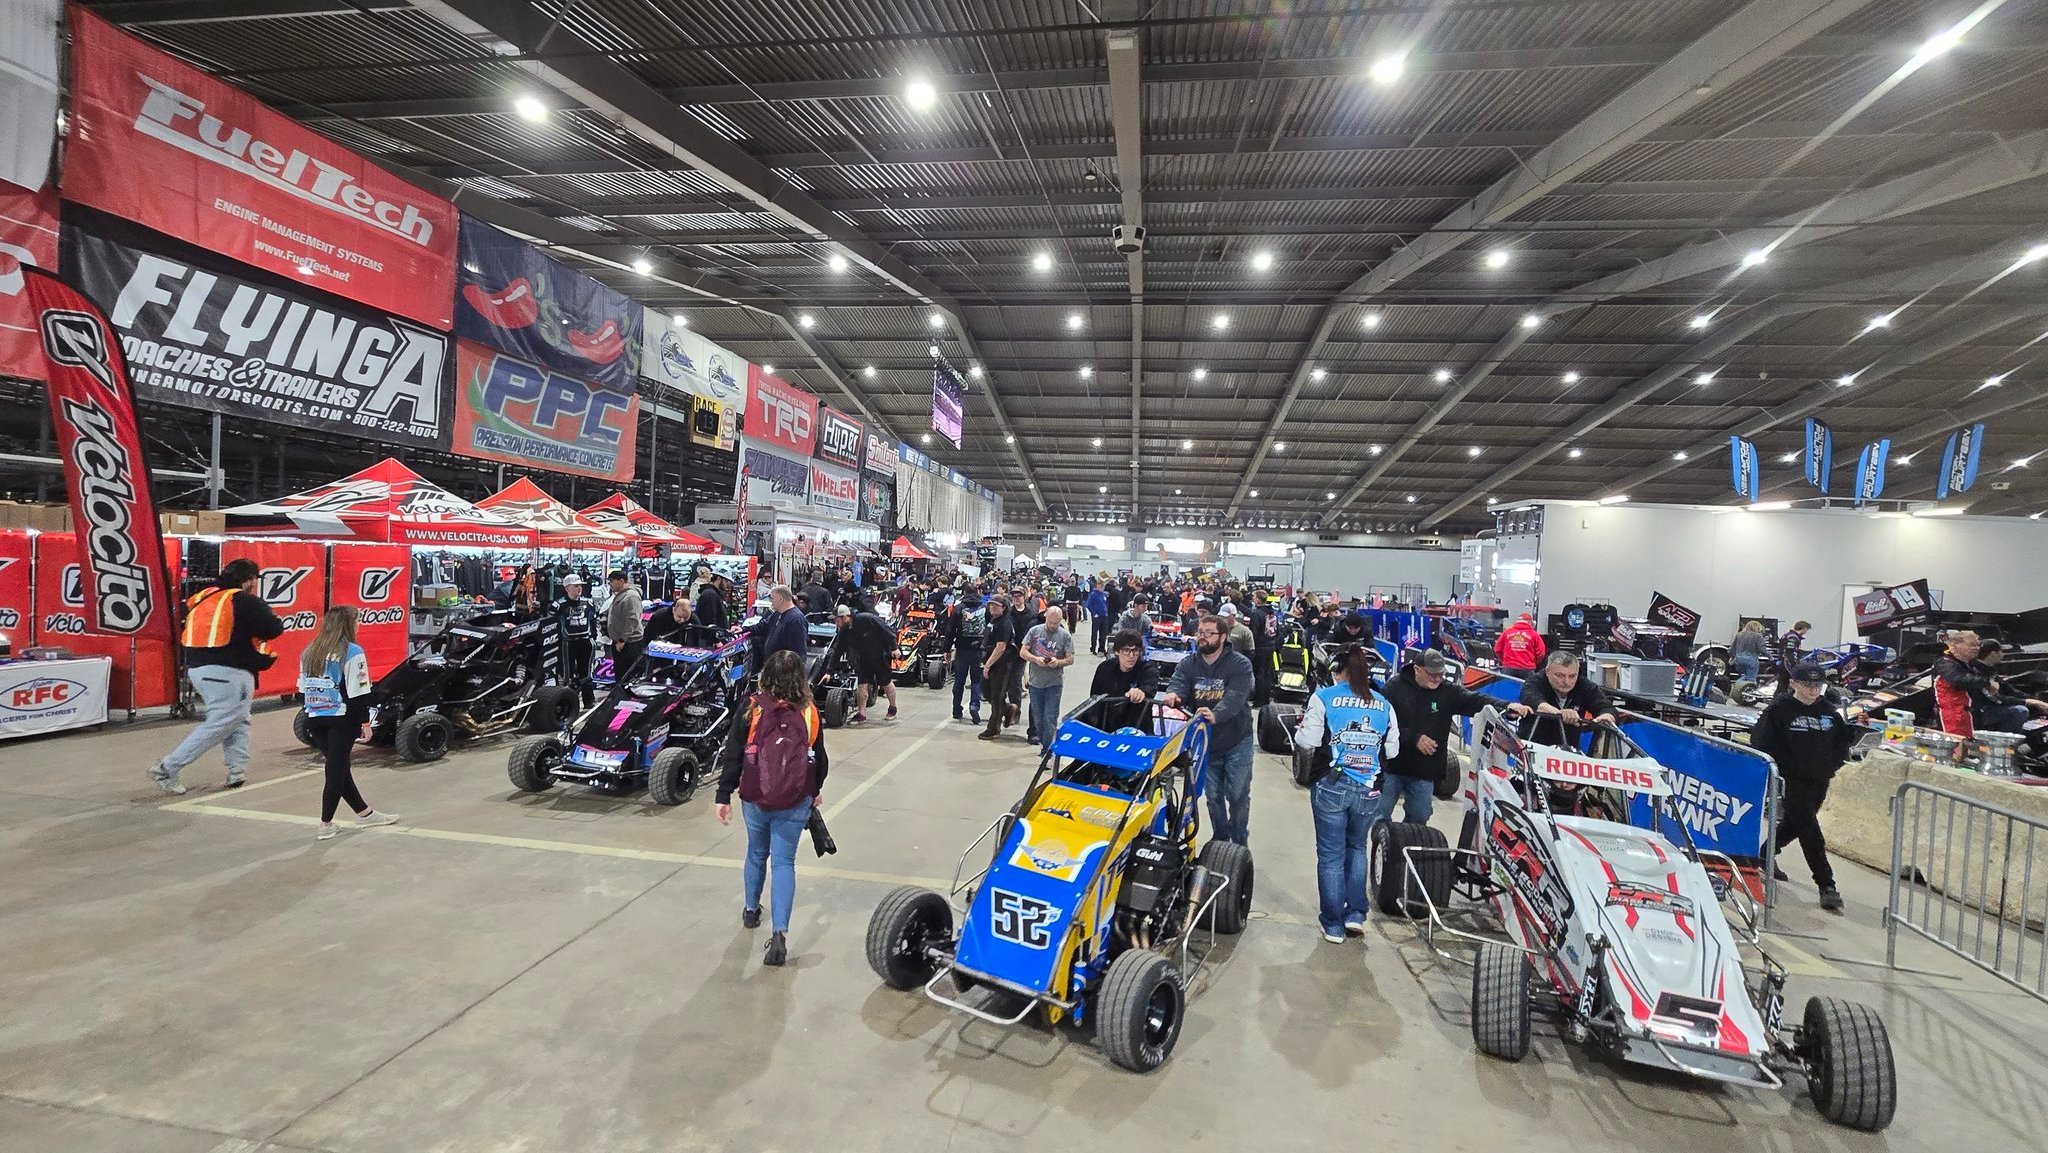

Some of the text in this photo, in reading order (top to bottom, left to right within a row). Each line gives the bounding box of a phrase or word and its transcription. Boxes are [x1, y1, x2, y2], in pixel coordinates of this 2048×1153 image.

[136, 72, 433, 246] FuelTech
[214, 198, 384, 272] ENGINE MANAGEMENT SYSTEMS
[254, 240, 350, 282] www.FuelTech.net
[119, 334, 232, 381] OACHES
[260, 369, 360, 408] TRAILERS
[483, 354, 631, 445] PPC
[695, 397, 717, 413] RACE
[757, 390, 811, 443] TRD
[352, 414, 439, 439] 800-222-4004
[824, 416, 859, 455] Hyper
[474, 427, 616, 472] PRECISION PERFORMANCE CONCRETE
[1955, 429, 1971, 492] FOURTEEN
[812, 464, 858, 500] WHELEN
[1866, 442, 1880, 499] FOURTEEN
[405, 530, 529, 544] WWW.VELOCITA-USA.COM
[1890, 584, 1925, 610] 19
[46, 613, 86, 633] Velo
[13, 684, 68, 706] RFC
[45, 707, 78, 717] CHRIST
[1331, 695, 1385, 711] OFFICIAL
[1546, 757, 1654, 789] RODGERS
[1661, 766, 1754, 825] NERGY
[1136, 848, 1163, 862] Guhl
[991, 887, 1053, 950] 52
[1652, 991, 1724, 1038] 5
